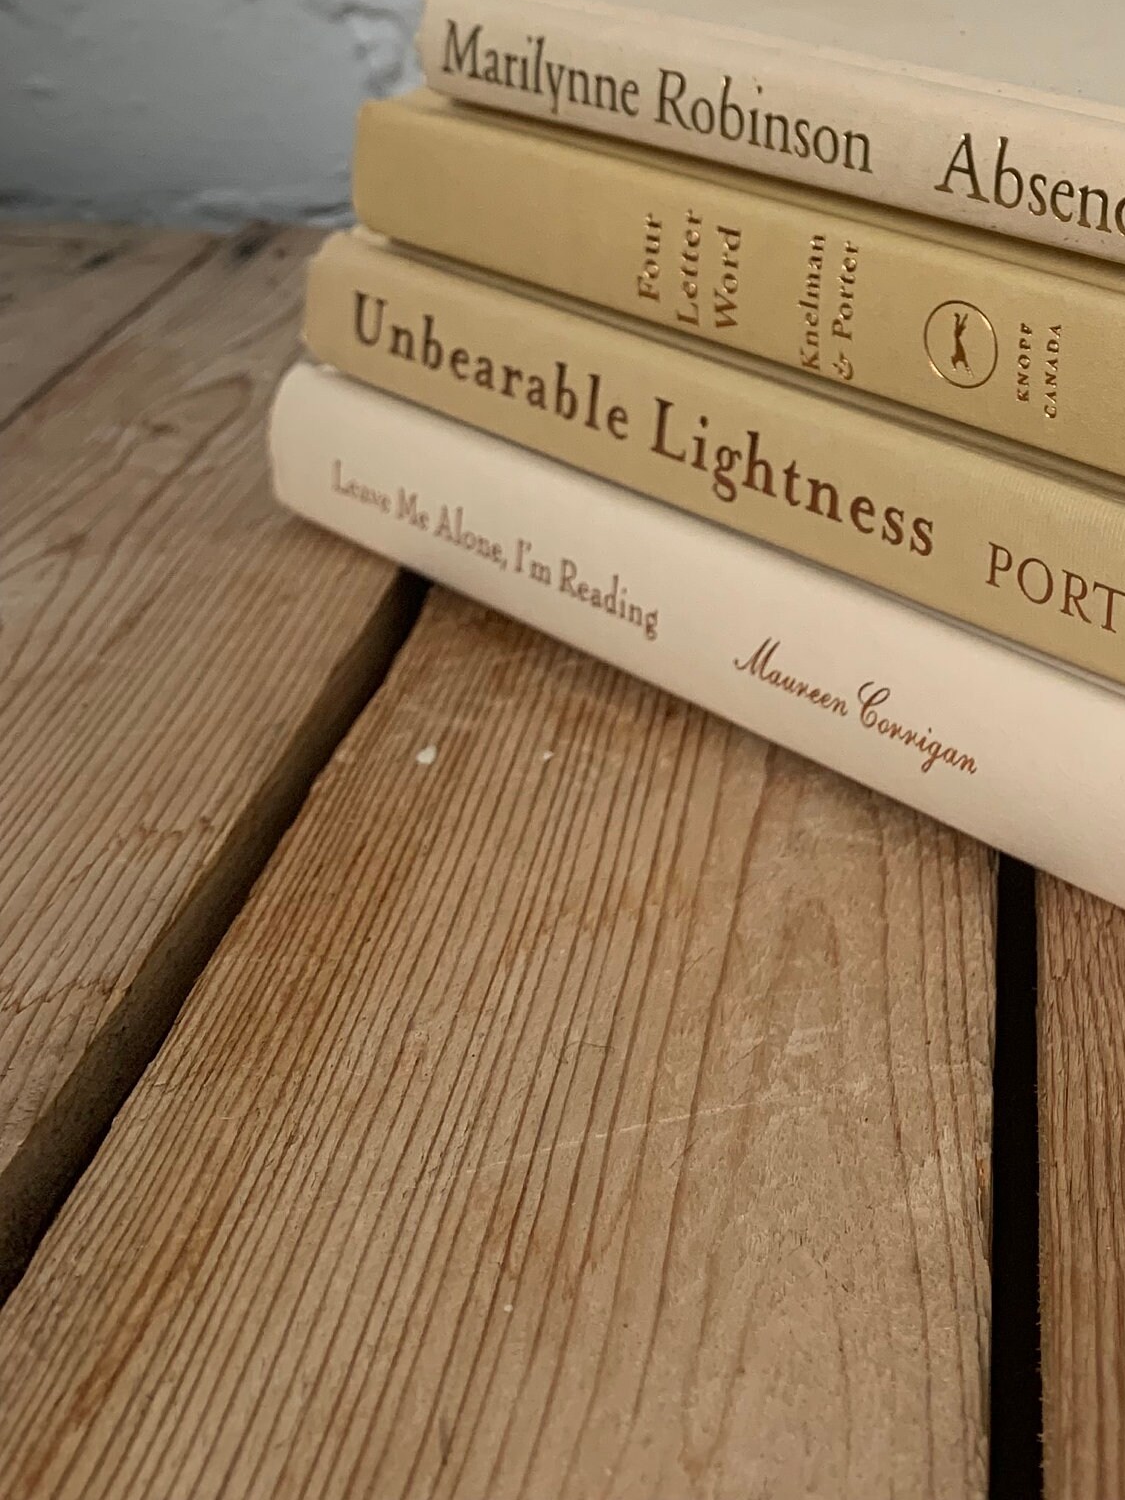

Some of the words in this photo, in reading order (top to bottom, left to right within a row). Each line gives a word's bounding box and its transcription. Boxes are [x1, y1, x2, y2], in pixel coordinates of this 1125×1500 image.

[442, 18, 640, 114] Marilynne
[654, 68, 874, 174] Robinson
[637, 212, 663, 303] Four
[676, 208, 703, 328] Letter
[714, 225, 742, 330] Word
[798, 233, 826, 371] Knelman
[831, 240, 860, 341] Porter
[1016, 322, 1034, 403] KNOPF
[1043, 323, 1062, 419] CANADA
[353, 290, 629, 441] Unbearable
[650, 397, 935, 557] Lightness
[331, 459, 391, 512] Leave
[395, 487, 430, 531] Me
[433, 507, 508, 570] Alone,
[514, 537, 553, 586] I'm
[559, 557, 659, 641] Reading
[733, 636, 849, 718] Maureen
[857, 680, 978, 775] Corrigan
